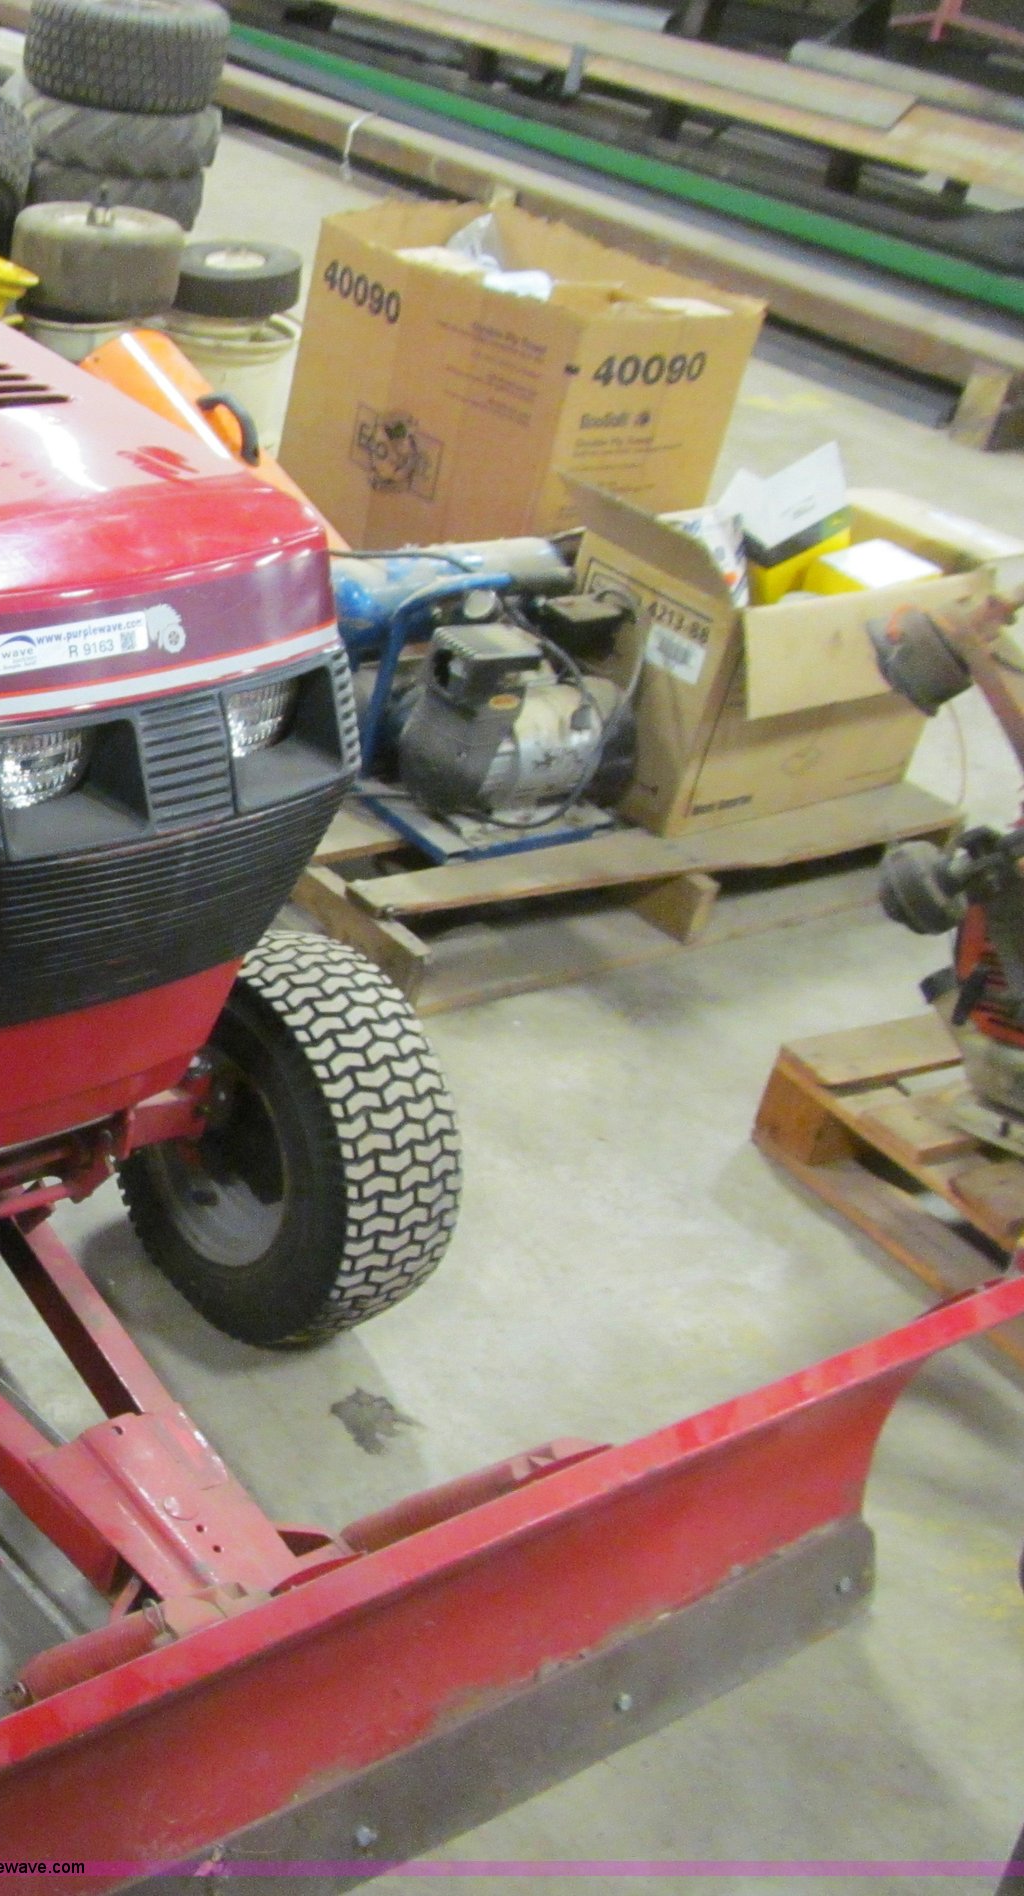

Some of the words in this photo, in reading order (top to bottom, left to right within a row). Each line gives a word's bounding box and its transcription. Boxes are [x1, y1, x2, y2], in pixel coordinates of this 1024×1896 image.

[324, 260, 400, 324] 40090
[592, 351, 707, 386] 40090
[2, 647, 34, 659] wave
[68, 644, 79, 657] R
[82, 638, 114, 656] 9163
